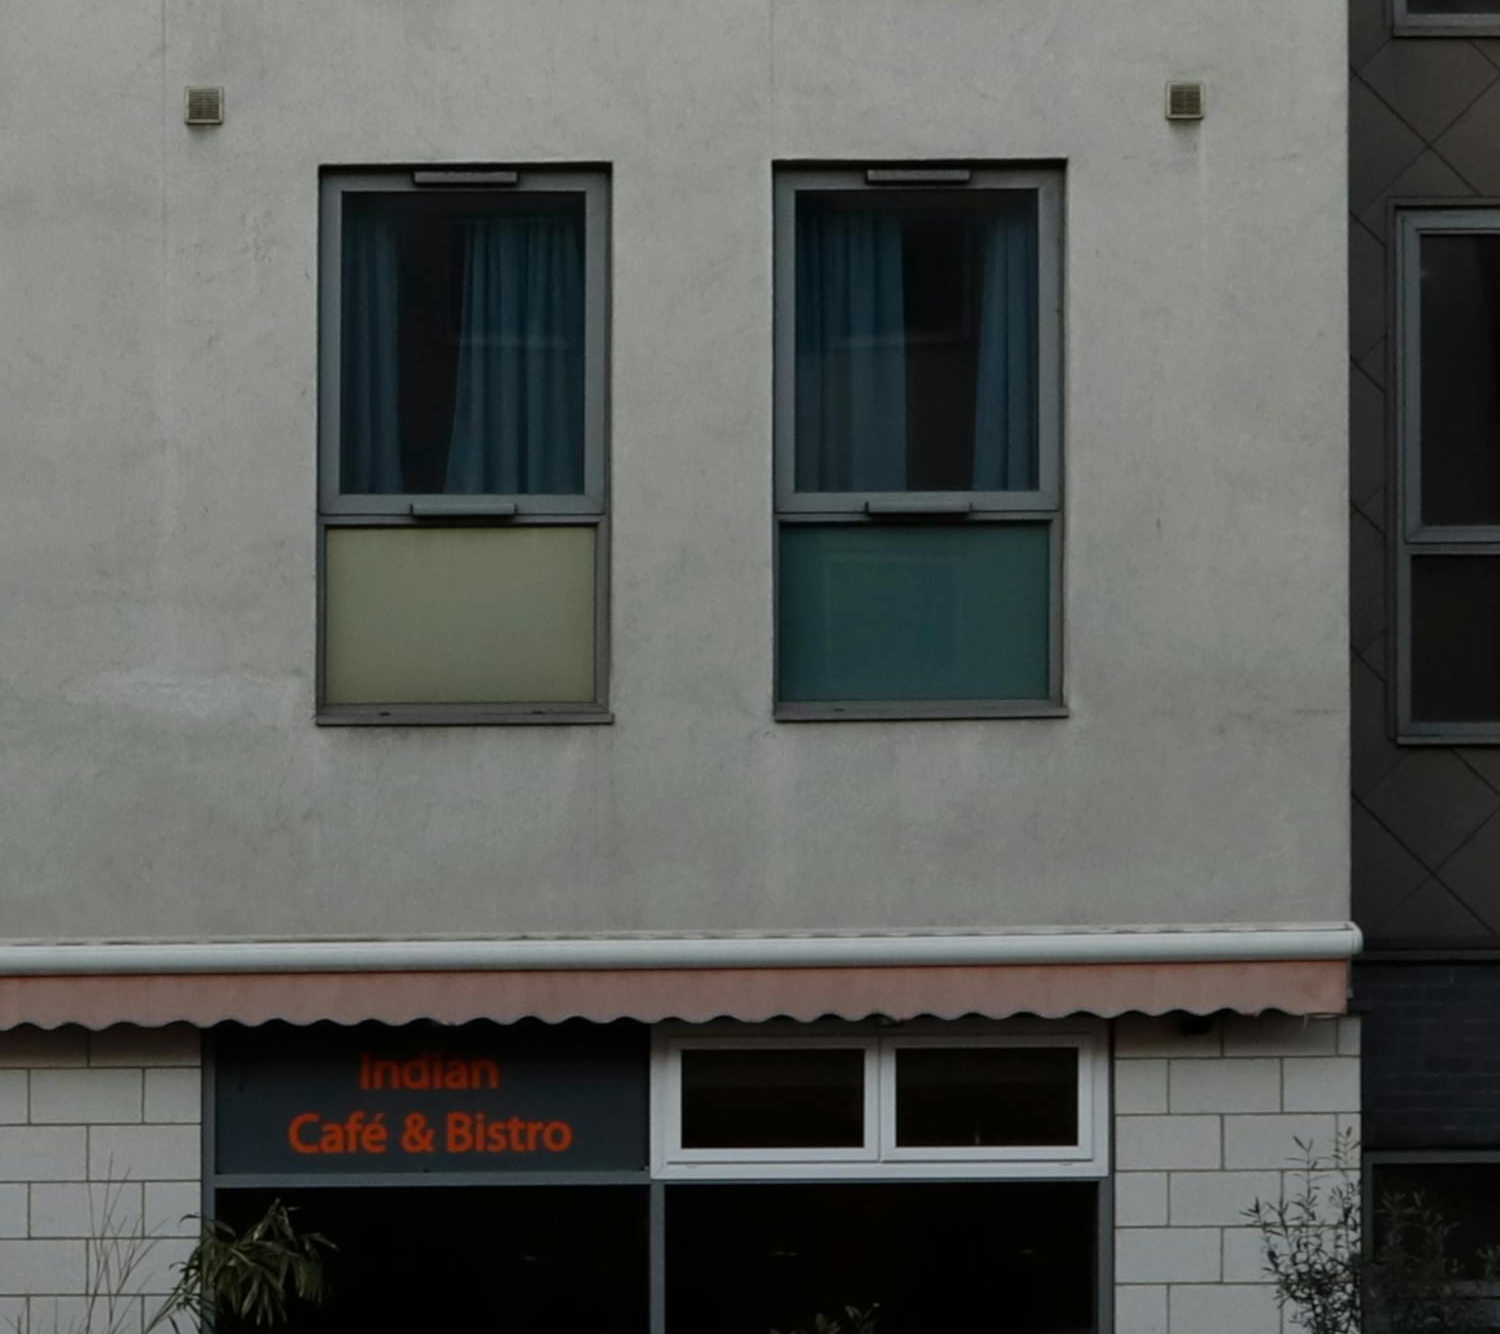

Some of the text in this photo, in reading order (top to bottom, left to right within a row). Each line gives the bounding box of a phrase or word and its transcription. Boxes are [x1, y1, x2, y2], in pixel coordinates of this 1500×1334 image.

[360, 1049, 500, 1091] Indian
[288, 1111, 573, 1155] Café & Bistro
